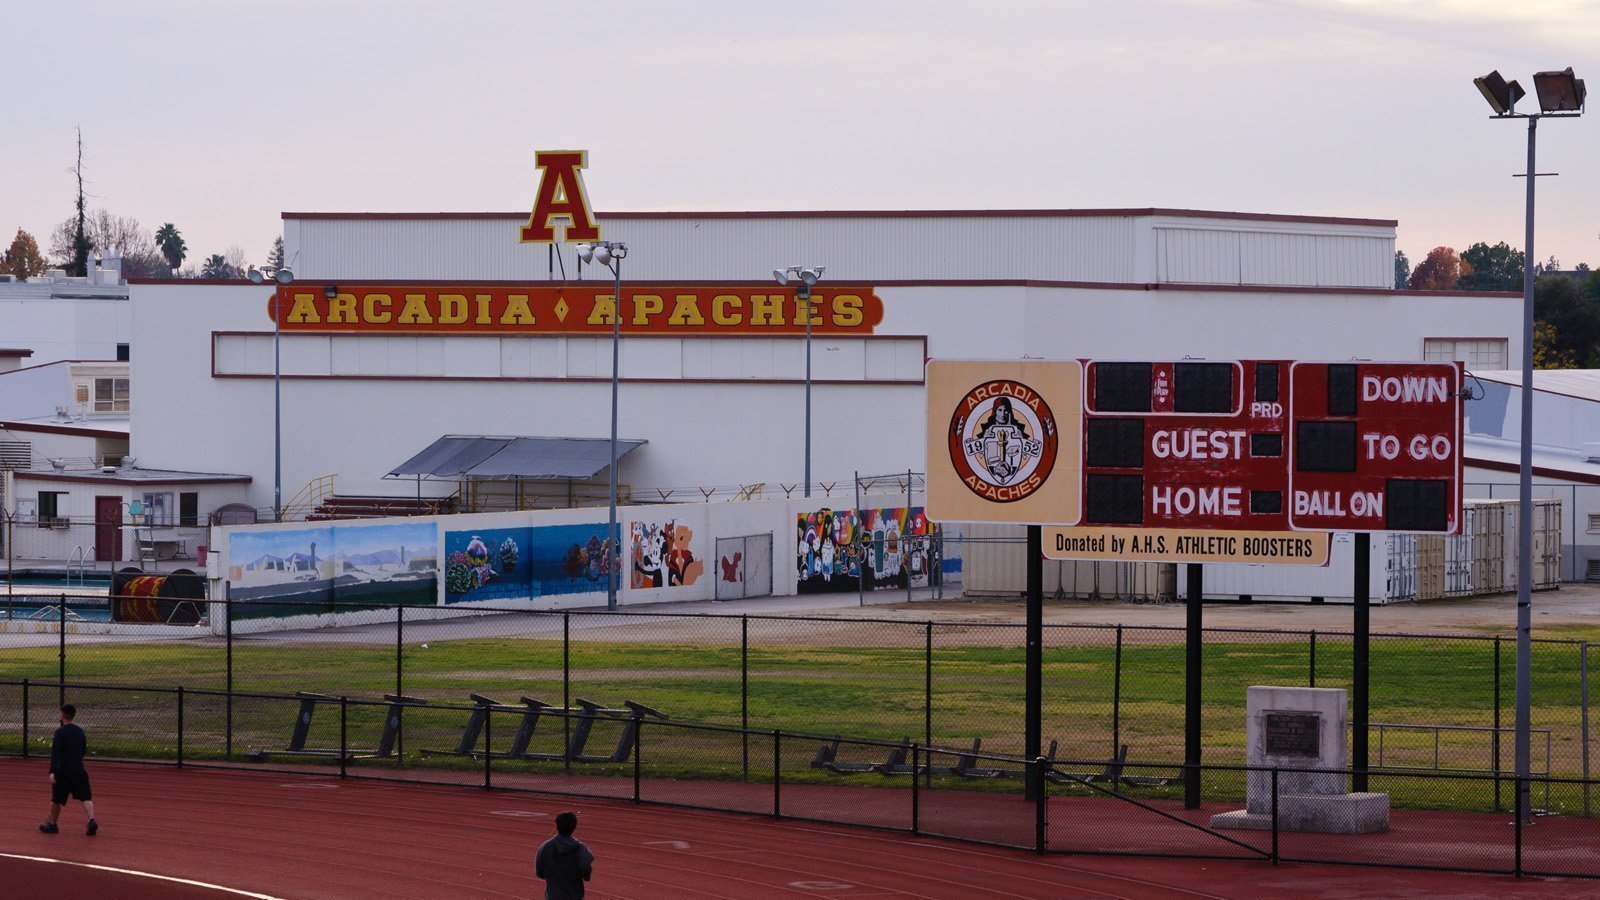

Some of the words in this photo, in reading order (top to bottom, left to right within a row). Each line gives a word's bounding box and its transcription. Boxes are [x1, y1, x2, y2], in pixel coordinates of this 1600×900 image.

[520, 149, 601, 243] A
[286, 294, 537, 325] ARCADIA
[586, 294, 864, 327] APACHES
[966, 383, 1041, 411] ARCADIA
[1363, 377, 1447, 403] DOWN
[1251, 402, 1283, 418] PRD
[1151, 430, 1247, 460] GUEST
[1363, 434, 1400, 460] TO
[1409, 435, 1451, 461] GO
[965, 473, 1042, 501] APACHES
[1152, 486, 1243, 516] HOME
[1295, 490, 1346, 517] BALL
[1350, 491, 1384, 518] ON
[1056, 533, 1105, 552] Donated
[1112, 535, 1126, 555] by
[1131, 535, 1169, 555] A.H.S.
[1176, 536, 1237, 556] ATHLETIC
[1243, 537, 1313, 558] BOOSTERS
